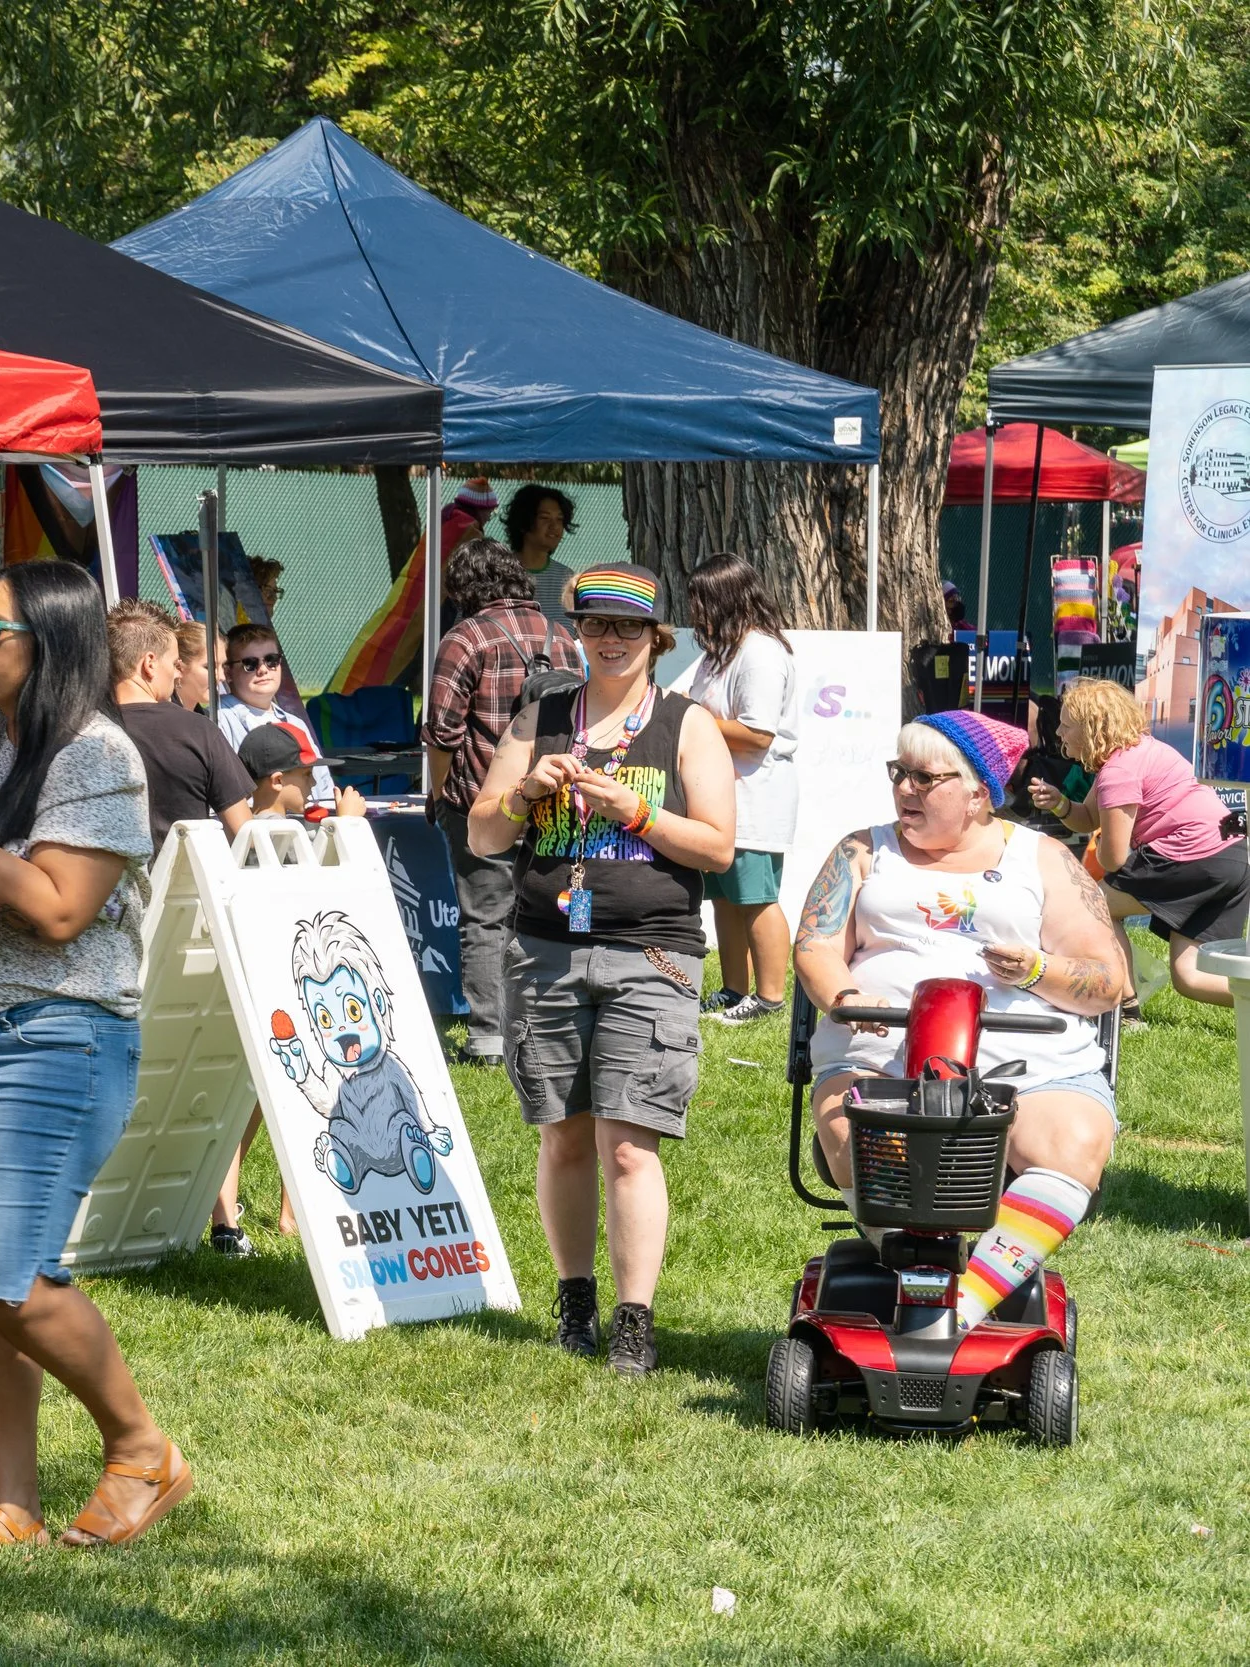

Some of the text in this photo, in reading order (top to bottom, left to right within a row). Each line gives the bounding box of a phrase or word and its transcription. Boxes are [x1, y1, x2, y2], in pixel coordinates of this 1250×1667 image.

[1183, 413, 1213, 464] SORENSON
[1213, 404, 1243, 418] LEGACY
[1181, 477, 1196, 516] CENTER
[1194, 516, 1207, 533] FOR
[1207, 525, 1242, 540] CLINICAL
[1217, 792, 1246, 805] RVICE
[536, 838, 556, 857] LIFE
[555, 839, 570, 857] IS
[429, 900, 461, 928] Uta
[336, 1201, 469, 1248] BABY YETI
[338, 1240, 491, 1290] SNOW CONES
